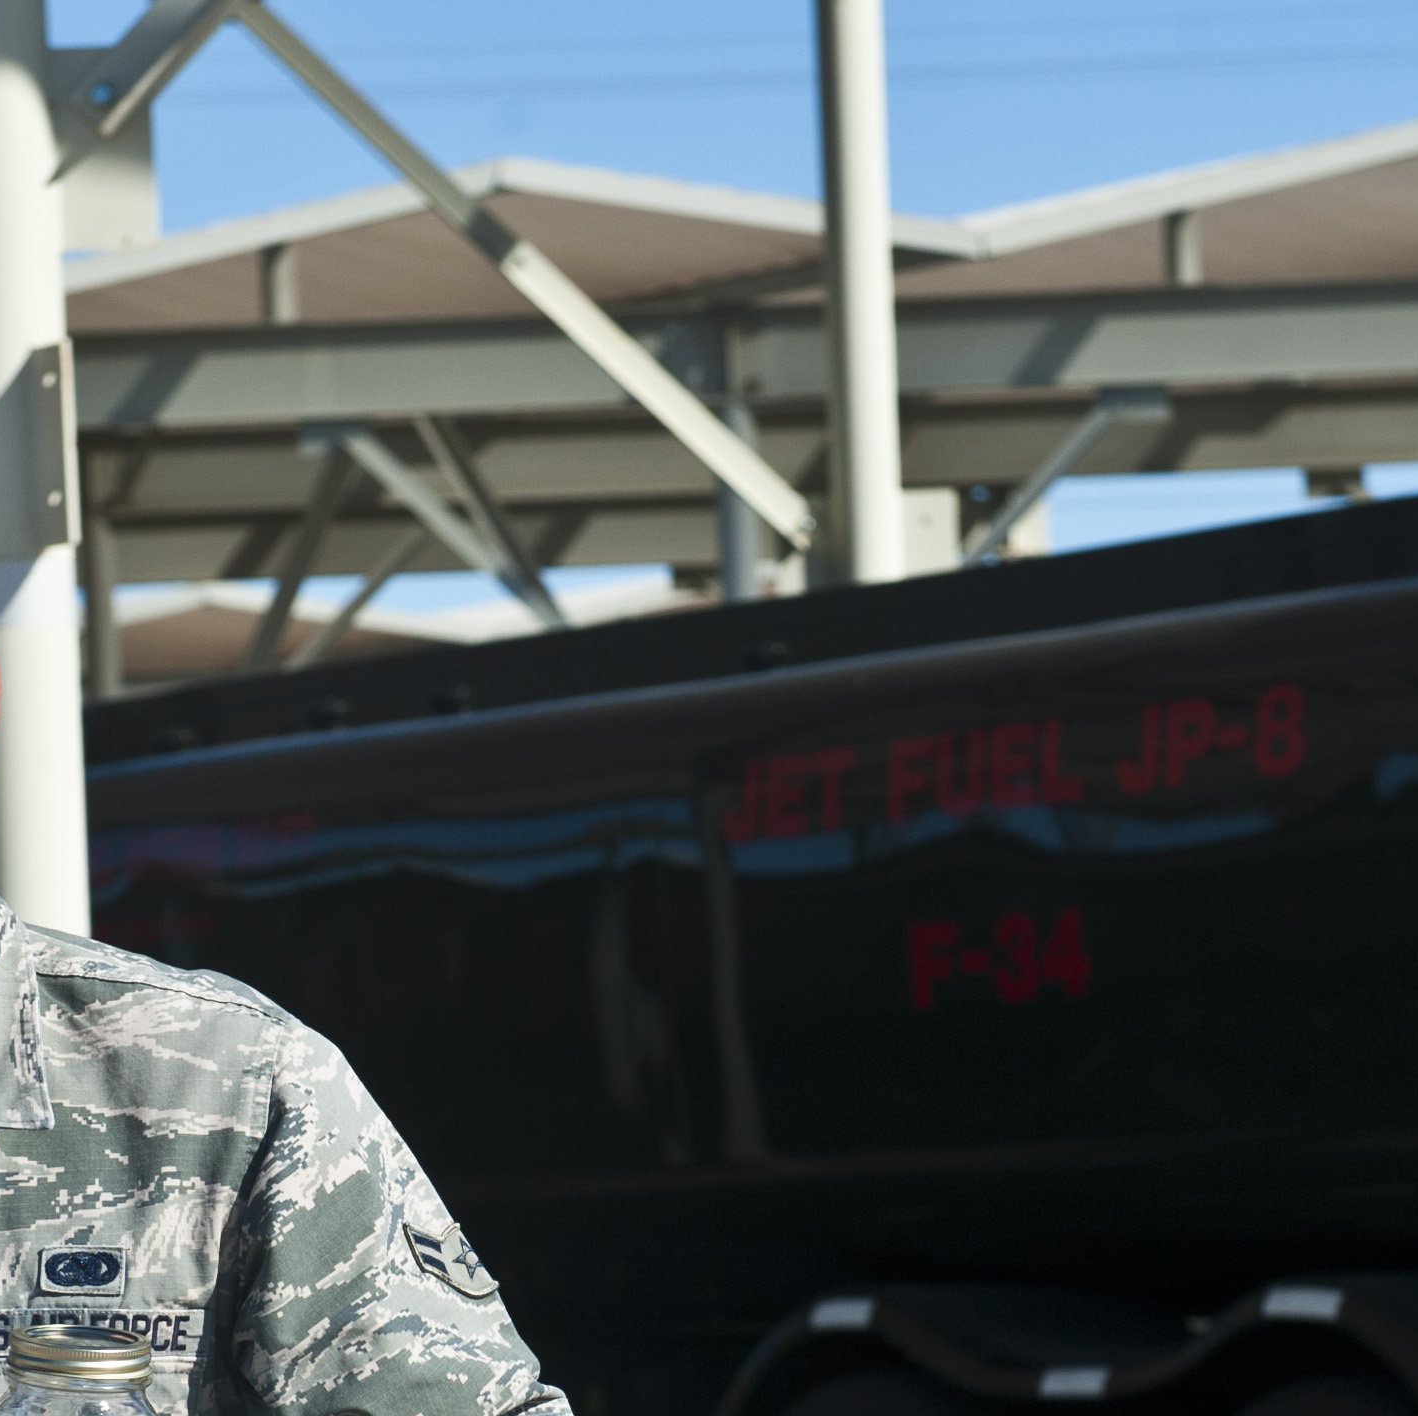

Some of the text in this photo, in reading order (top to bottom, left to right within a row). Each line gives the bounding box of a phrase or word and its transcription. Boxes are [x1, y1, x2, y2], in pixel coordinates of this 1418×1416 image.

[720, 682, 1307, 845] JET FUEL JP-8
[908, 908, 1090, 1011] F-34
